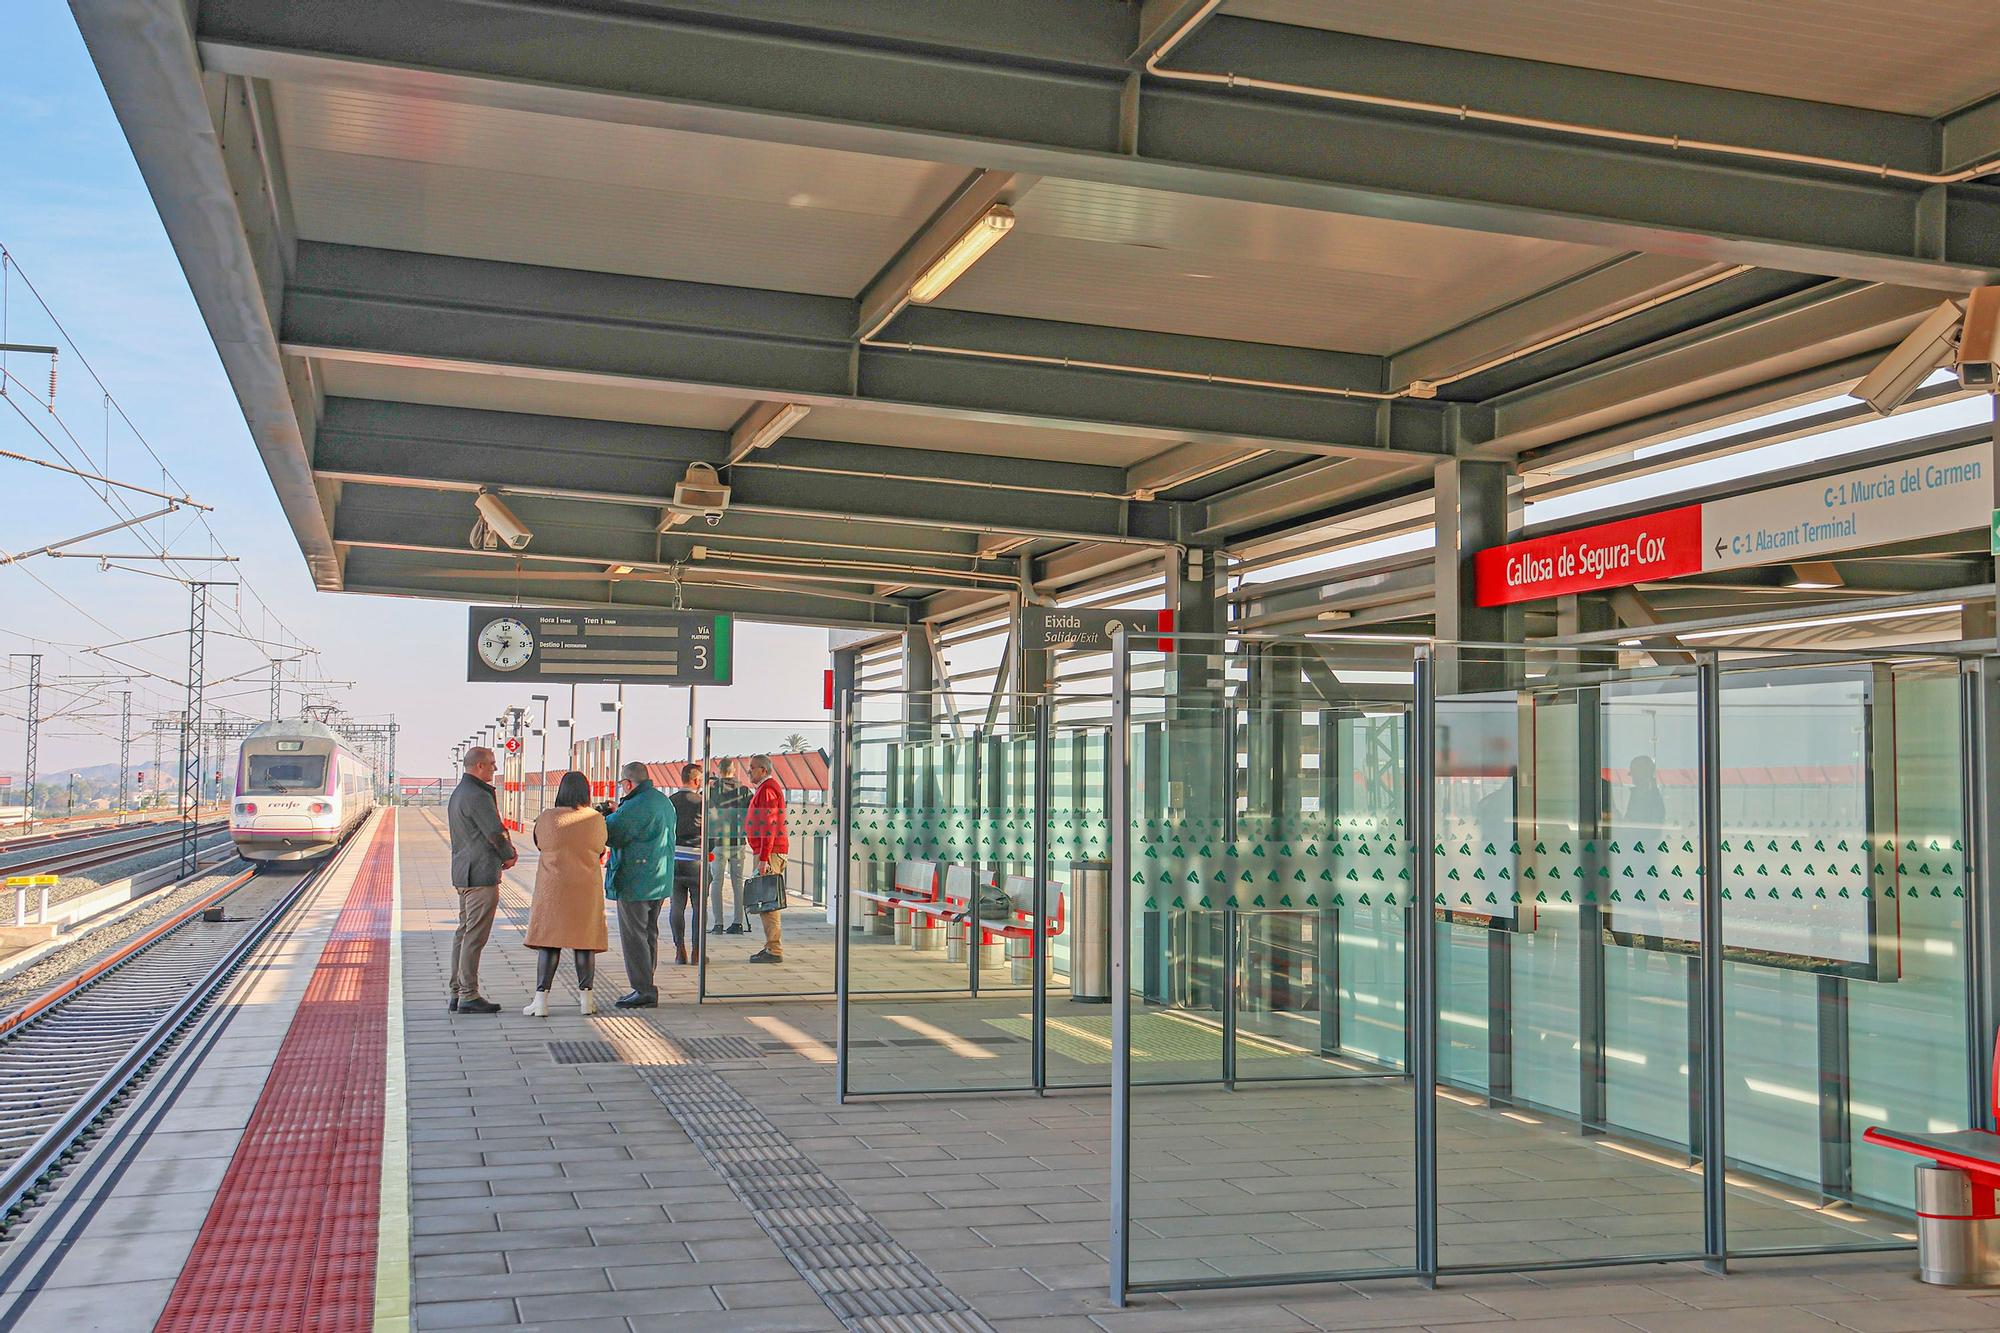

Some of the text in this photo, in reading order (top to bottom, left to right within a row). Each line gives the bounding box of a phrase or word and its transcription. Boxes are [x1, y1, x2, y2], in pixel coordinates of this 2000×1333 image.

[1824, 461, 1981, 508] C-1 Murcia del Carmen
[1732, 512, 1857, 555] C-1 Alacant Terminal
[1506, 532, 1666, 587] Callosa de Segura-Cox
[1044, 615, 1081, 628] Eixida
[1044, 631, 1099, 643] Salida/Exit
[693, 645, 708, 670] 3
[510, 740, 517, 750] 3
[268, 800, 301, 810] renfe
